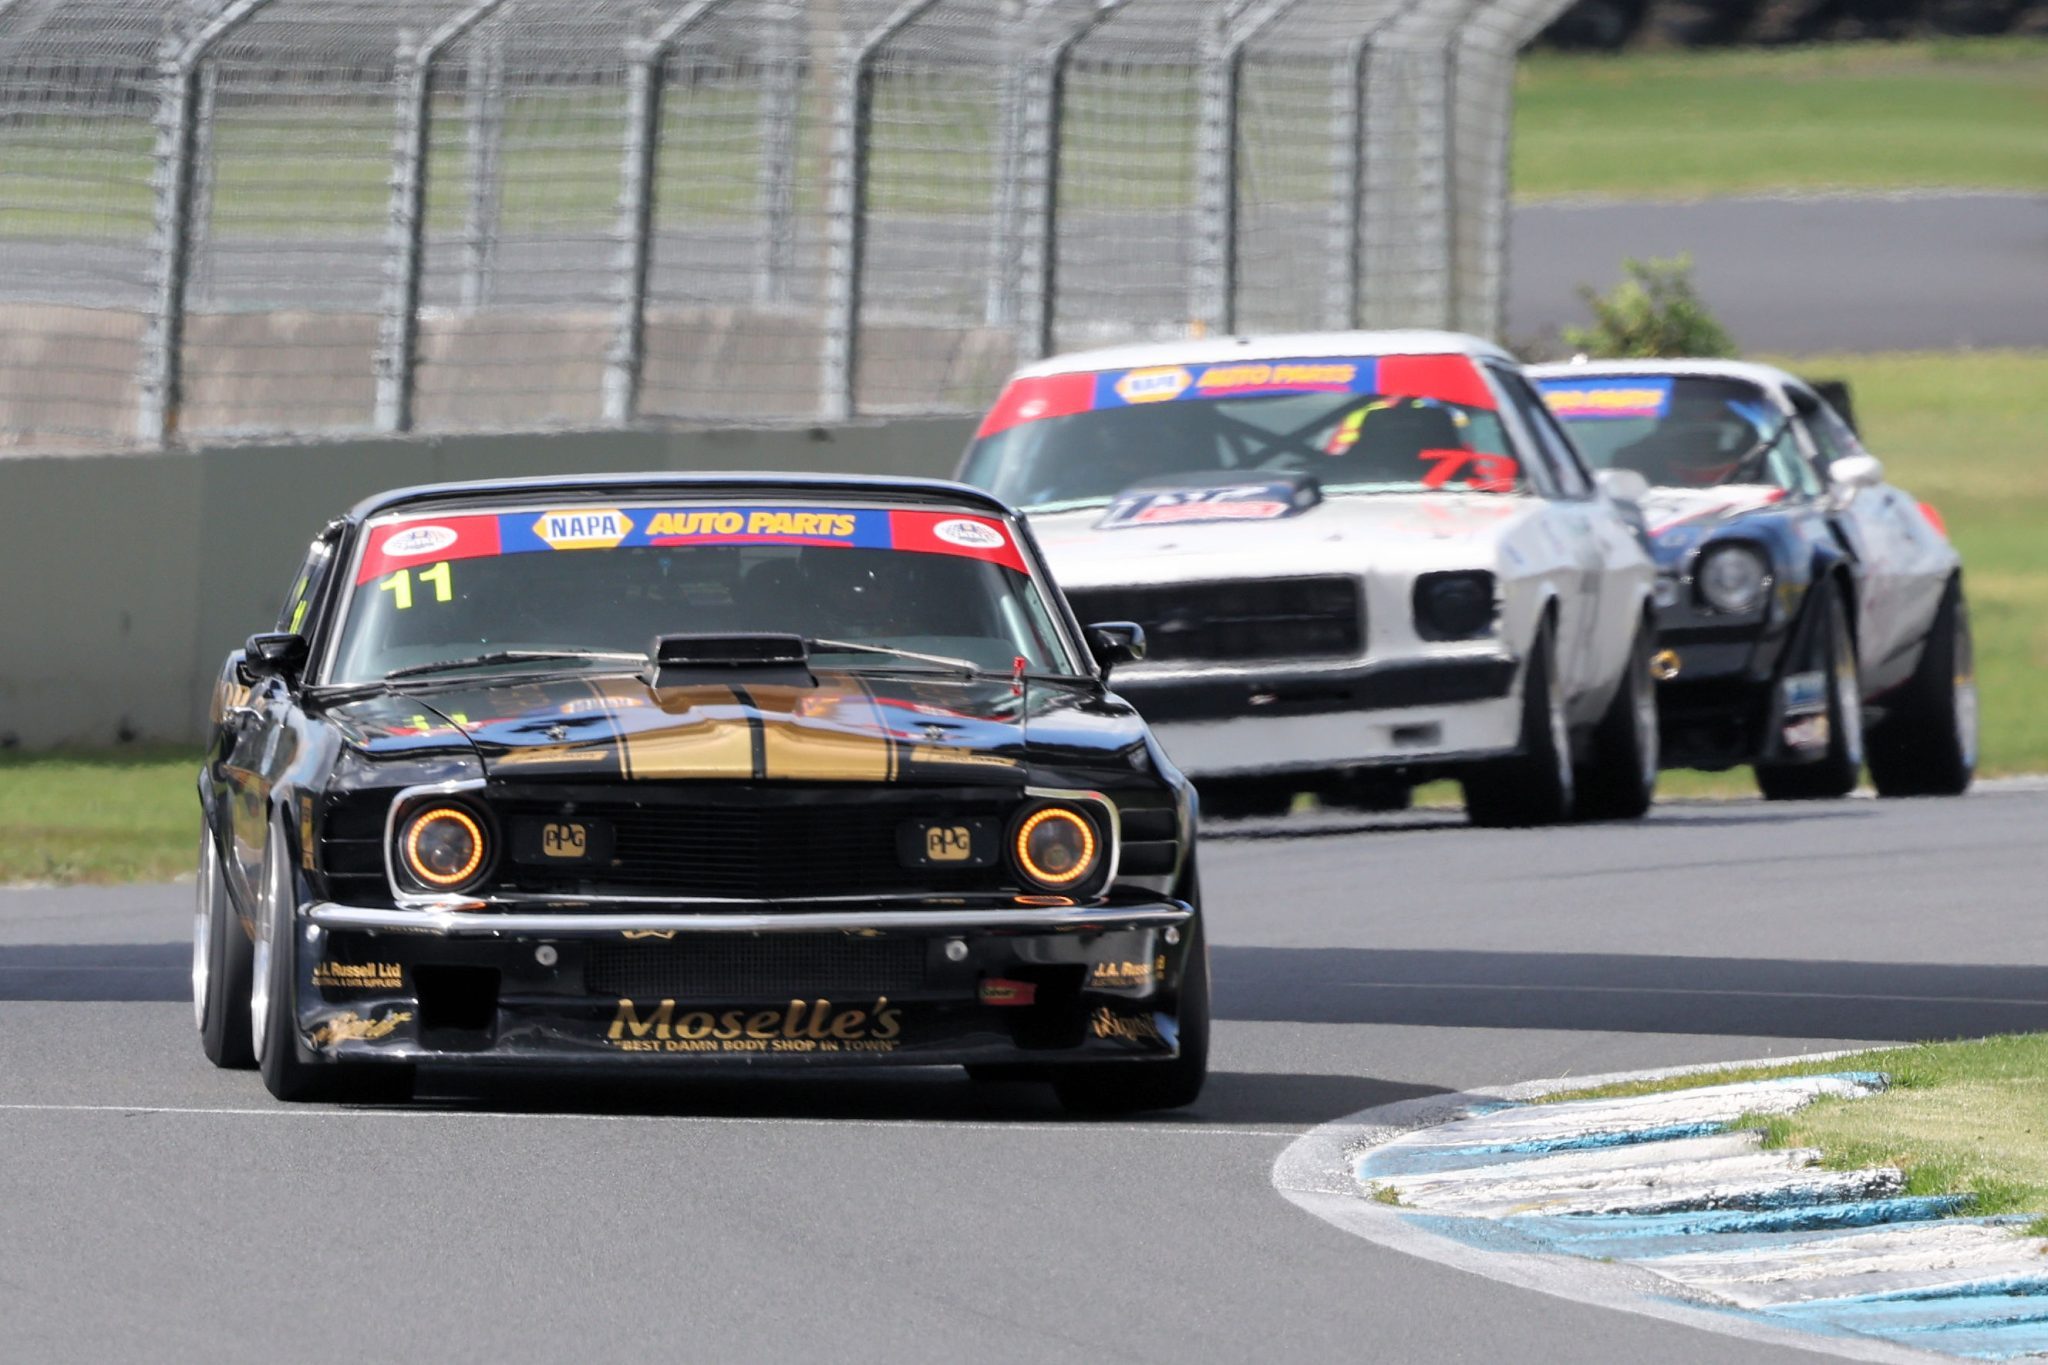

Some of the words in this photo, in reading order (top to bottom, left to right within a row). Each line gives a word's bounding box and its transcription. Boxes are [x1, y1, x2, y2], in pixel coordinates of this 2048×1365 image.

[551, 515, 617, 538] NAPA
[645, 512, 744, 536] AUTO
[747, 512, 856, 537] PARTS
[380, 561, 452, 610] 11
[544, 823, 586, 851] PPG
[928, 826, 970, 855] PPG
[379, 962, 402, 978] Ltd
[608, 996, 902, 1040] Moselle's
[668, 1039, 718, 1052] DAMN
[723, 1039, 768, 1052] BODY
[771, 1039, 816, 1051] SHOP
[820, 1039, 840, 1051] IN
